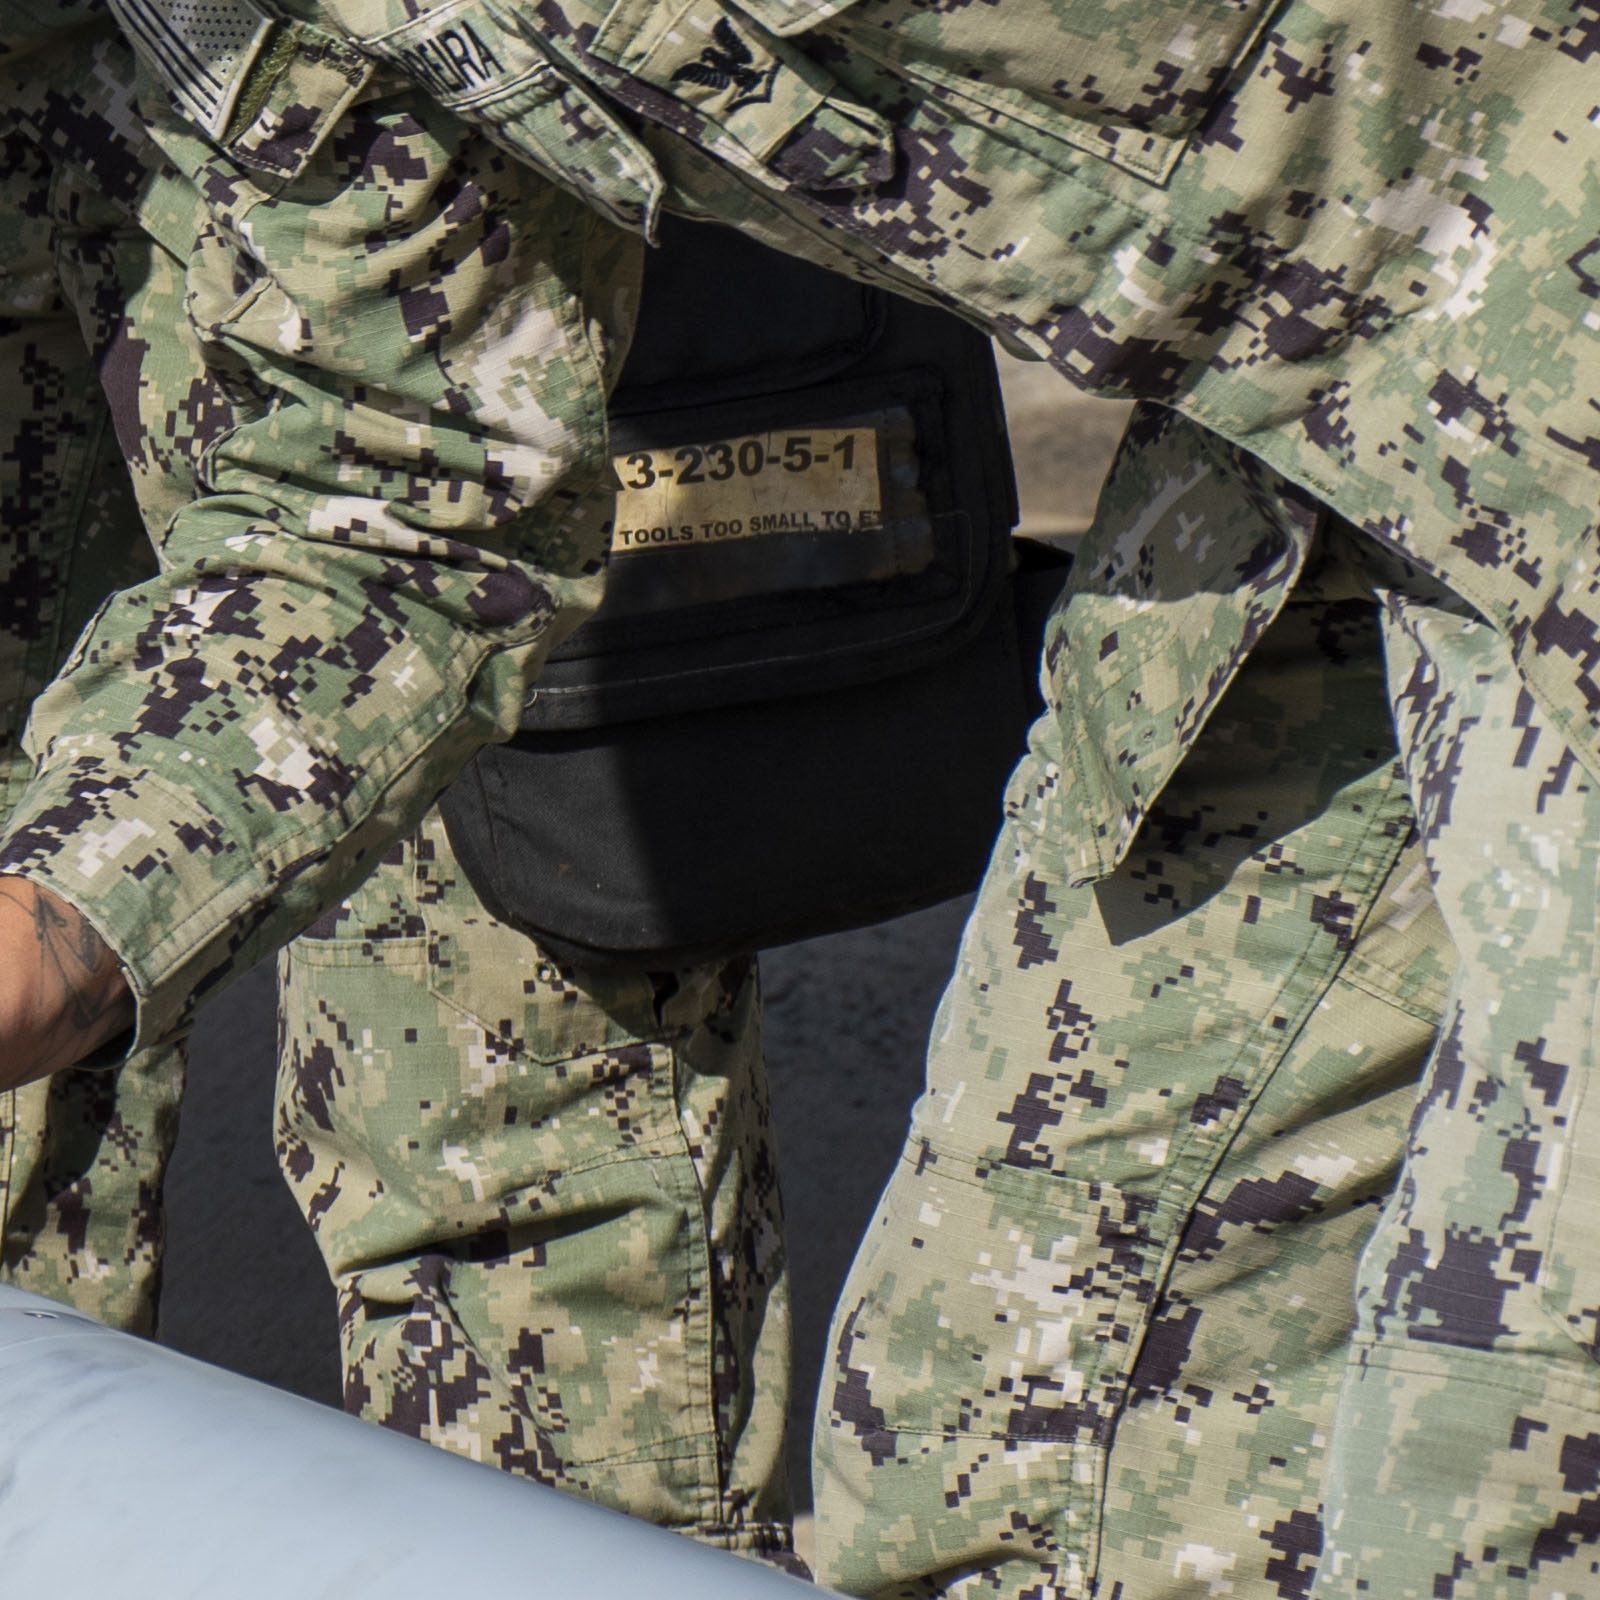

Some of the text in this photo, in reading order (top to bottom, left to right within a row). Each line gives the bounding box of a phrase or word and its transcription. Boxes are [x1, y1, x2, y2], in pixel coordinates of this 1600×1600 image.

[615, 434, 857, 493] 3-230-5-1
[619, 524, 694, 546] TOOLS
[702, 520, 743, 541] TOO
[749, 512, 816, 534] SMALL
[822, 510, 851, 529] TO
